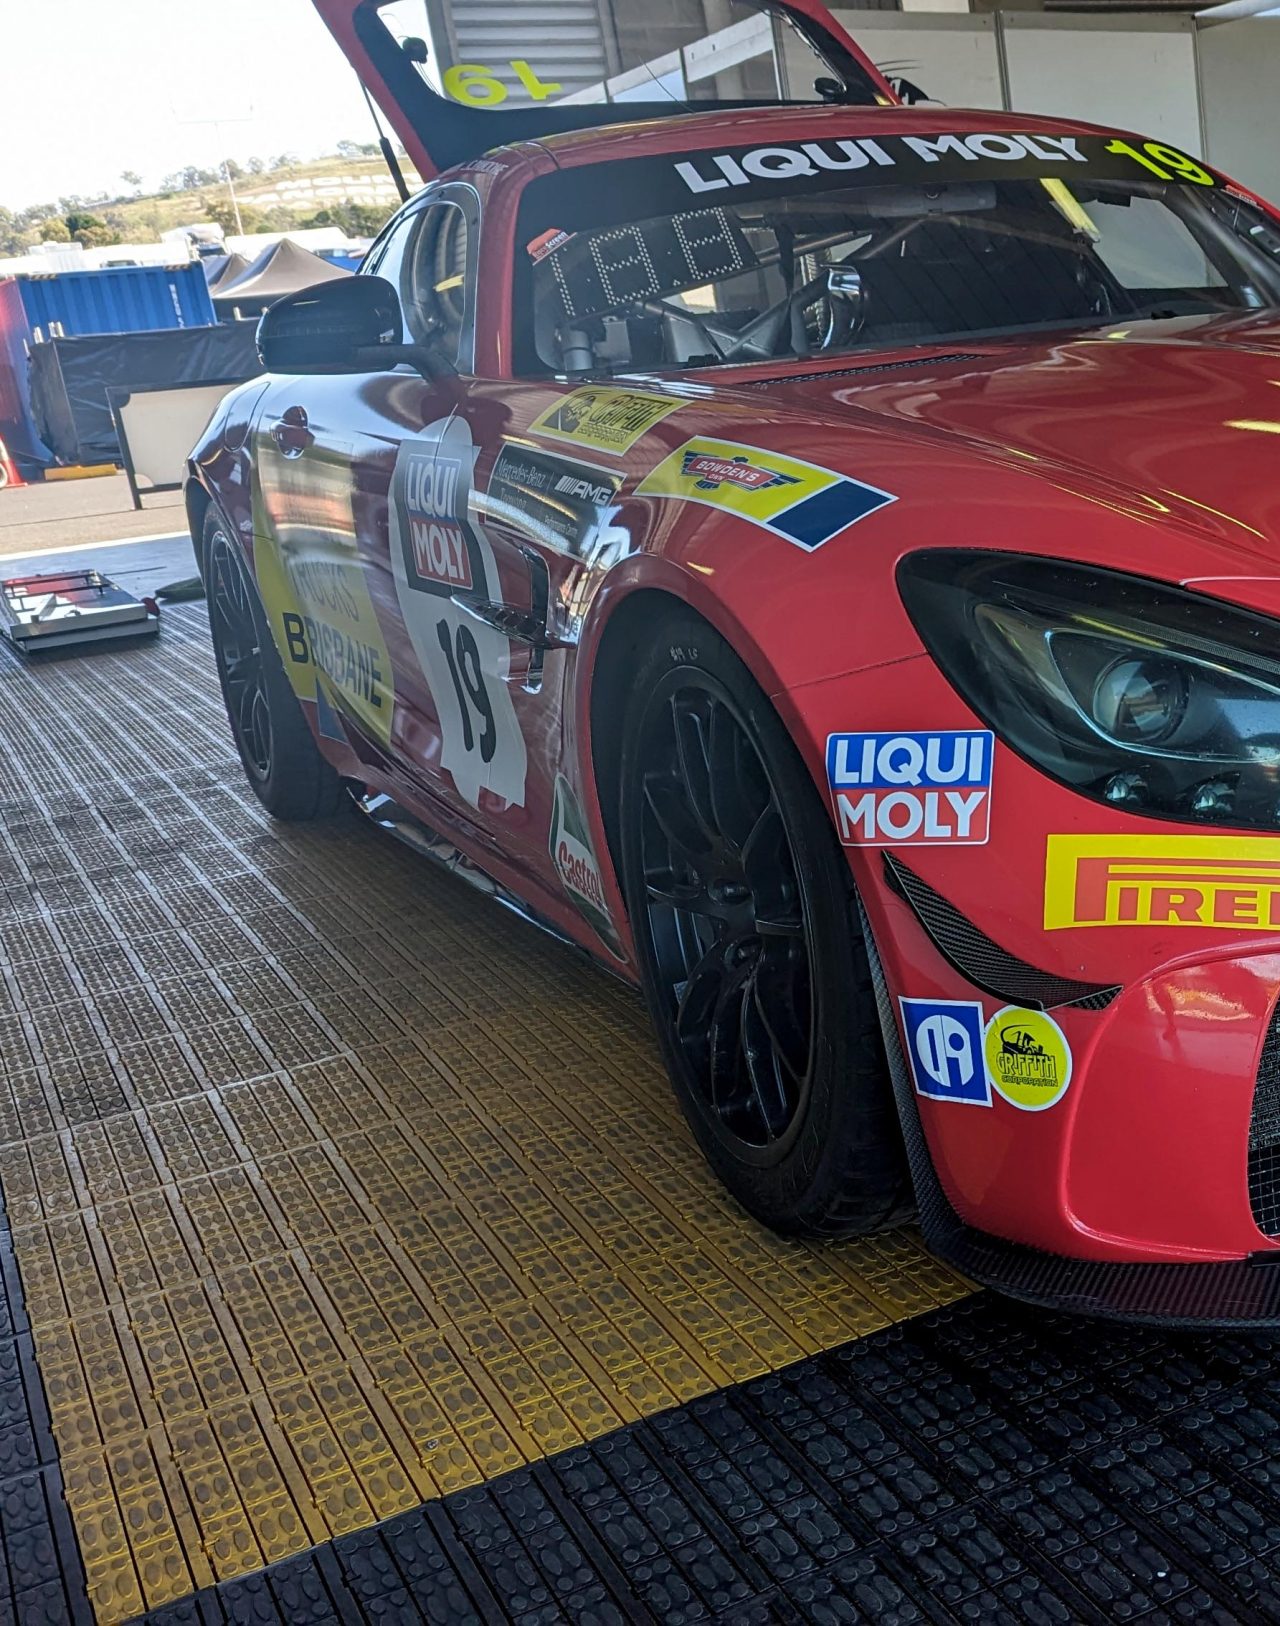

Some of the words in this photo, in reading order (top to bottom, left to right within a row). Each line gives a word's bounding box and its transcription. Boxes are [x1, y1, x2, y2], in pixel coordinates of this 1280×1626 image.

[673, 138, 896, 194] LIQUI
[901, 134, 1089, 163] MOLY
[1104, 138, 1215, 186] 19
[408, 462, 456, 519] LIQUI
[571, 480, 612, 506] AMG
[696, 461, 760, 482] BOWDEN'S
[413, 521, 465, 580] MOLY
[283, 612, 382, 708] BRISBANE
[436, 618, 497, 763] 19
[835, 737, 984, 786] LIQUI
[837, 791, 986, 839] MOLY
[559, 841, 602, 906] Castrol
[997, 1052, 1056, 1079] GRIFFITH
[1002, 1075, 1058, 1088] CORPORATION
